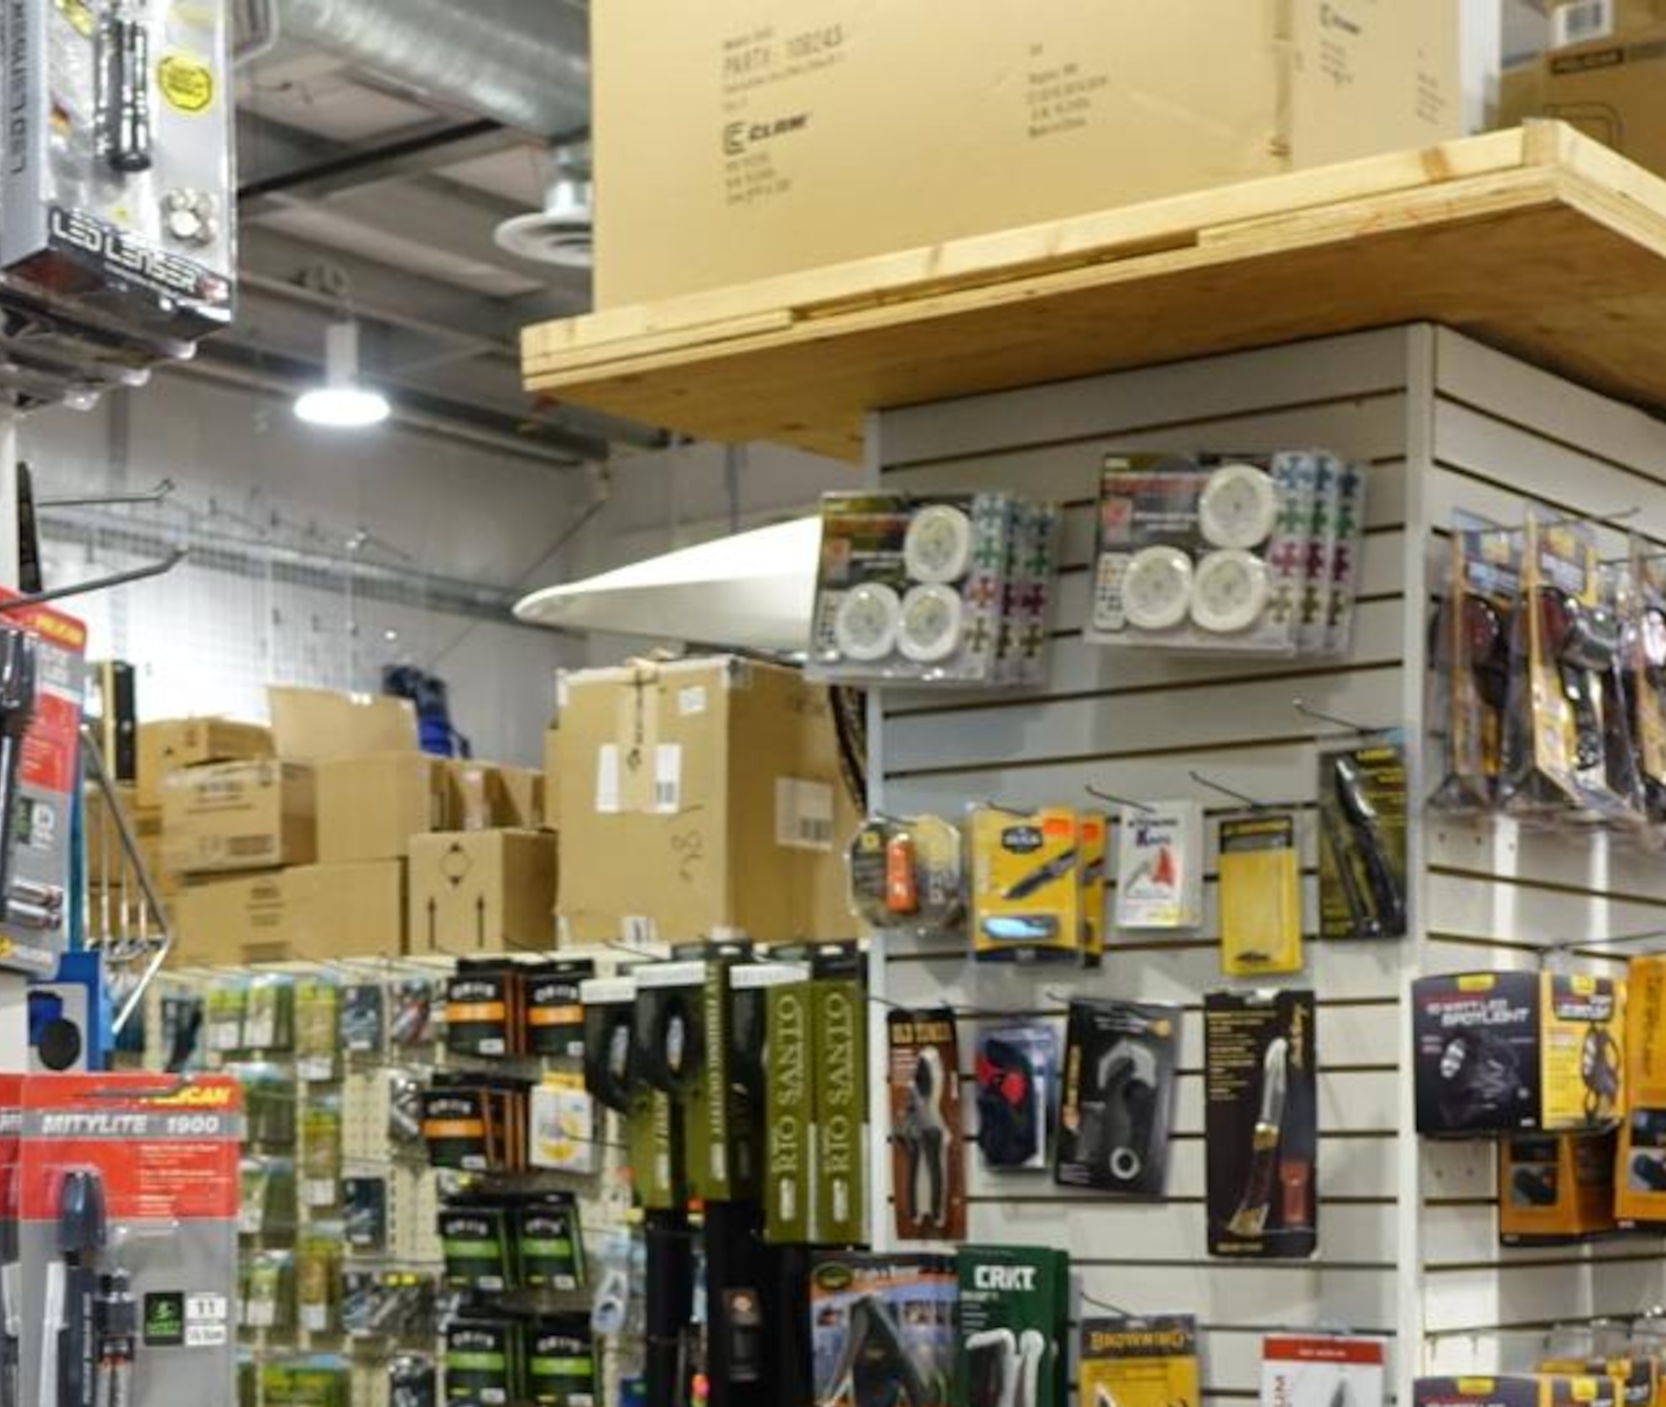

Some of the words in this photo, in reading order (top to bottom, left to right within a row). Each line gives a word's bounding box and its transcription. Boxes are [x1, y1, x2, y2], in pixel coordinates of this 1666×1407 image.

[777, 994, 801, 1106] SANTO
[827, 992, 851, 1106] SANTO
[42, 1114, 149, 1135] MITYLITE
[166, 1115, 220, 1135] 1900
[974, 1265, 1037, 1291] CRKT
[1090, 1330, 1185, 1349] BROWNING
